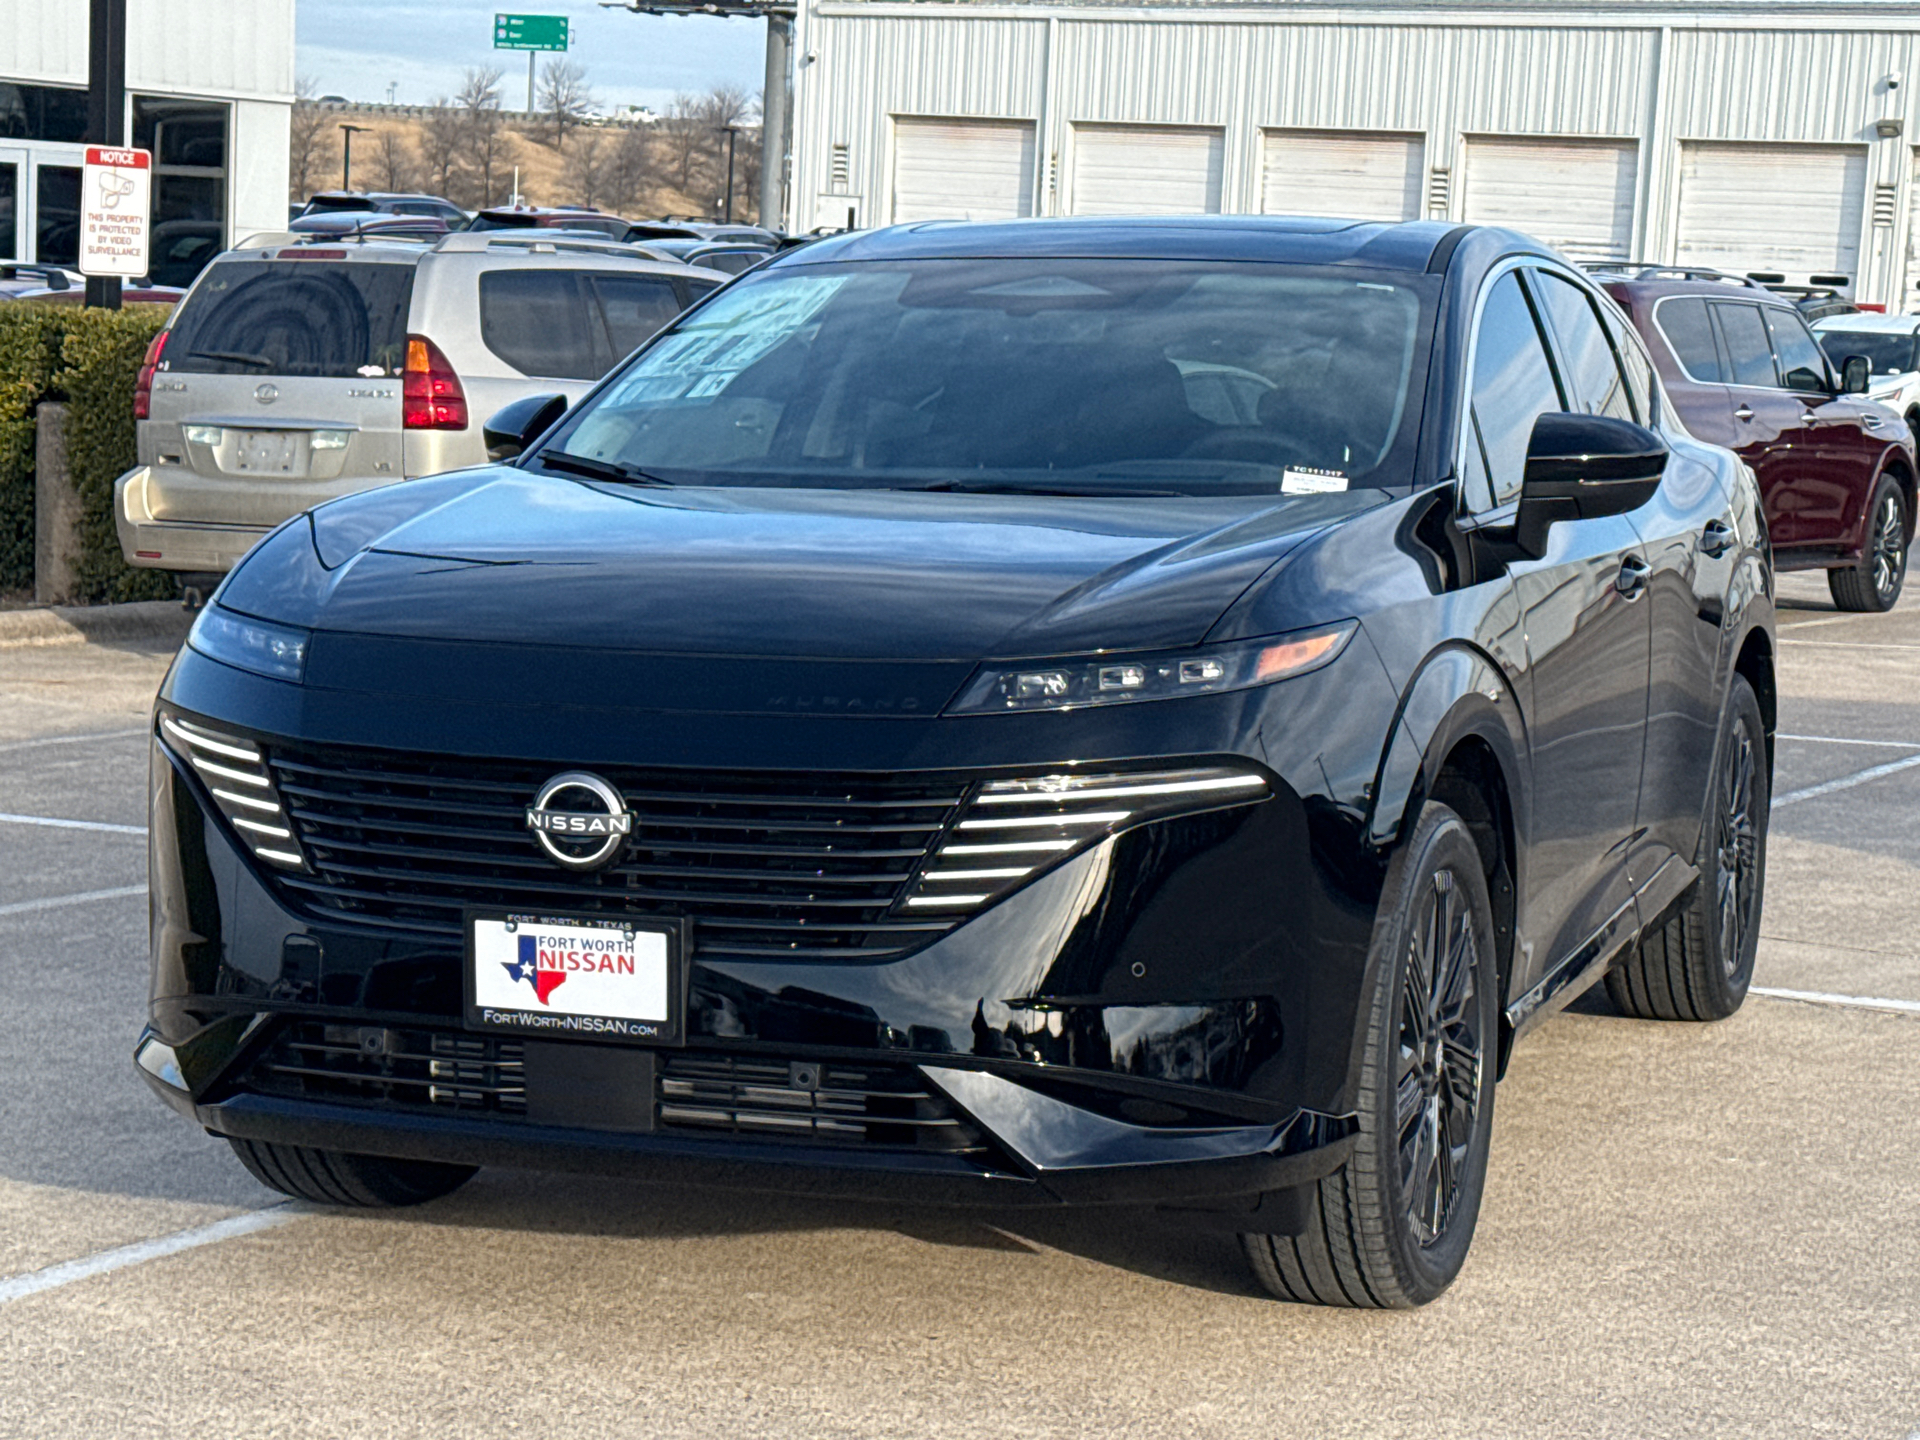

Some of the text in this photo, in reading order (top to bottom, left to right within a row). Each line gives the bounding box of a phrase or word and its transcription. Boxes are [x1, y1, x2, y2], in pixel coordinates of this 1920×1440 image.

[100, 151, 135, 165] NOTICE
[88, 213, 143, 224] THIS PROPERTY
[89, 224, 141, 235] IS PROTECTED
[98, 235, 132, 245] BY VIDEO
[88, 245, 141, 256] SURVEILLANCE
[766, 696, 919, 709] MURANO
[528, 812, 627, 832] NISSAN
[507, 914, 632, 930] FORT WORTH TEXAS
[539, 936, 635, 953] FORT WORTH
[539, 949, 635, 975] NISSAN
